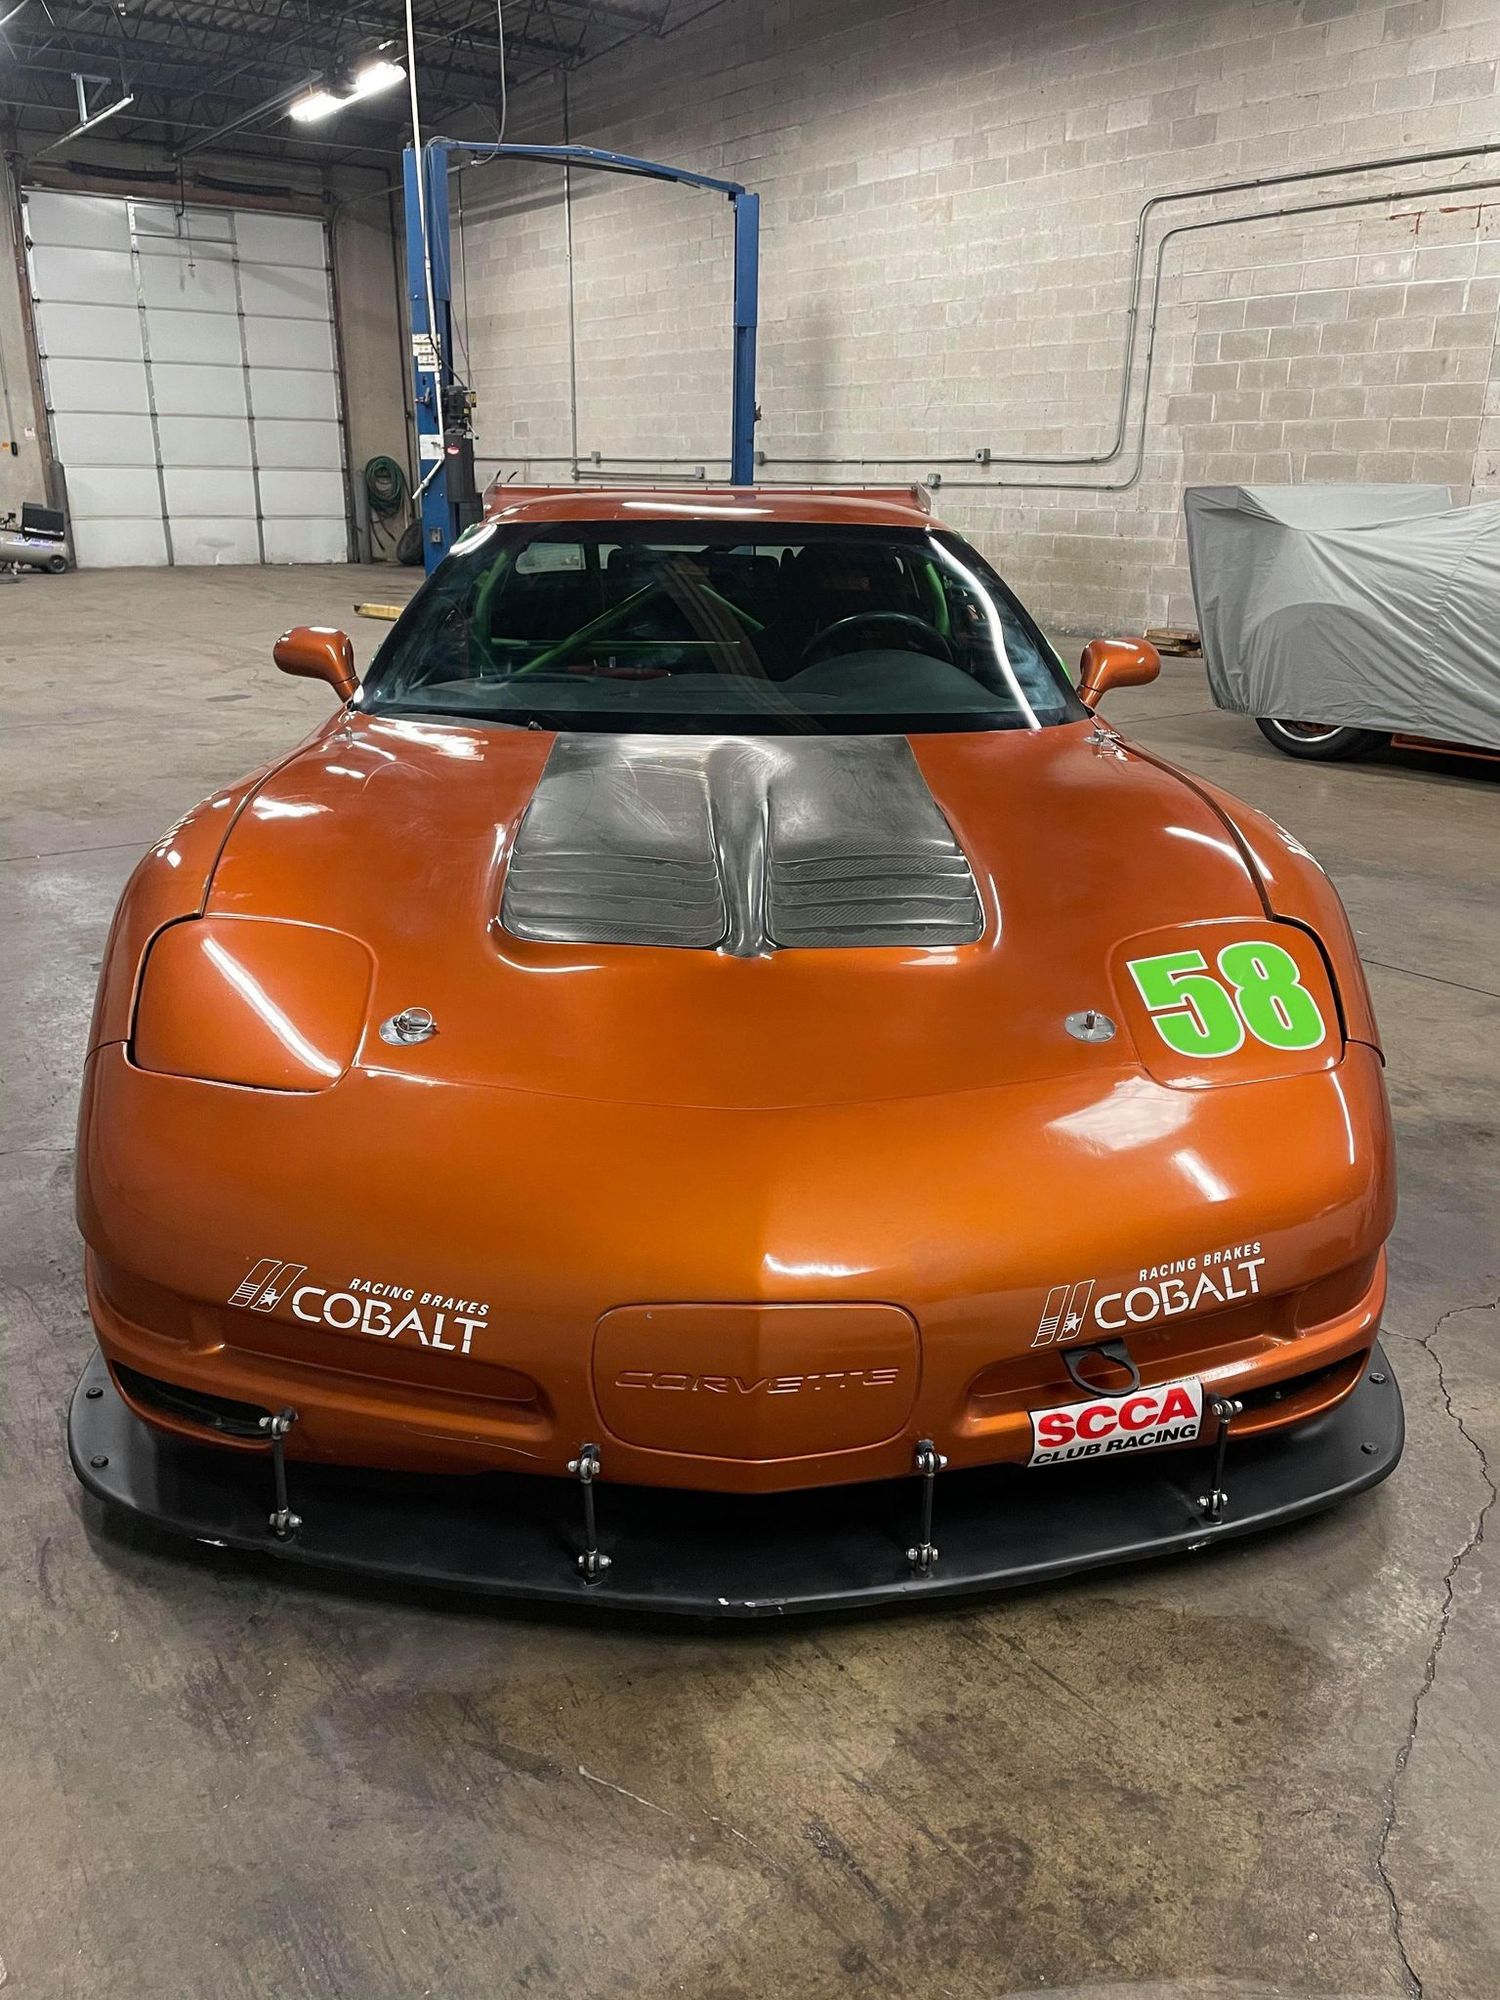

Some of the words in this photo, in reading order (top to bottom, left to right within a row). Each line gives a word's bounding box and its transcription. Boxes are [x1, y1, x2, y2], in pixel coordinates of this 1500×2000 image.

[1126, 940, 1326, 1058] 58
[1139, 1257, 1196, 1282] RACING
[1203, 1241, 1262, 1267] BRAKES
[349, 1278, 413, 1301] RACING
[419, 1292, 490, 1316] BRAKES
[1094, 1257, 1266, 1330] COBALT
[291, 1286, 489, 1354] COBALT
[615, 1369, 900, 1395] CORVETTE
[1037, 1386, 1198, 1448] SCCA
[1033, 1442, 1101, 1465] CLUB
[1105, 1424, 1198, 1453] RACING
